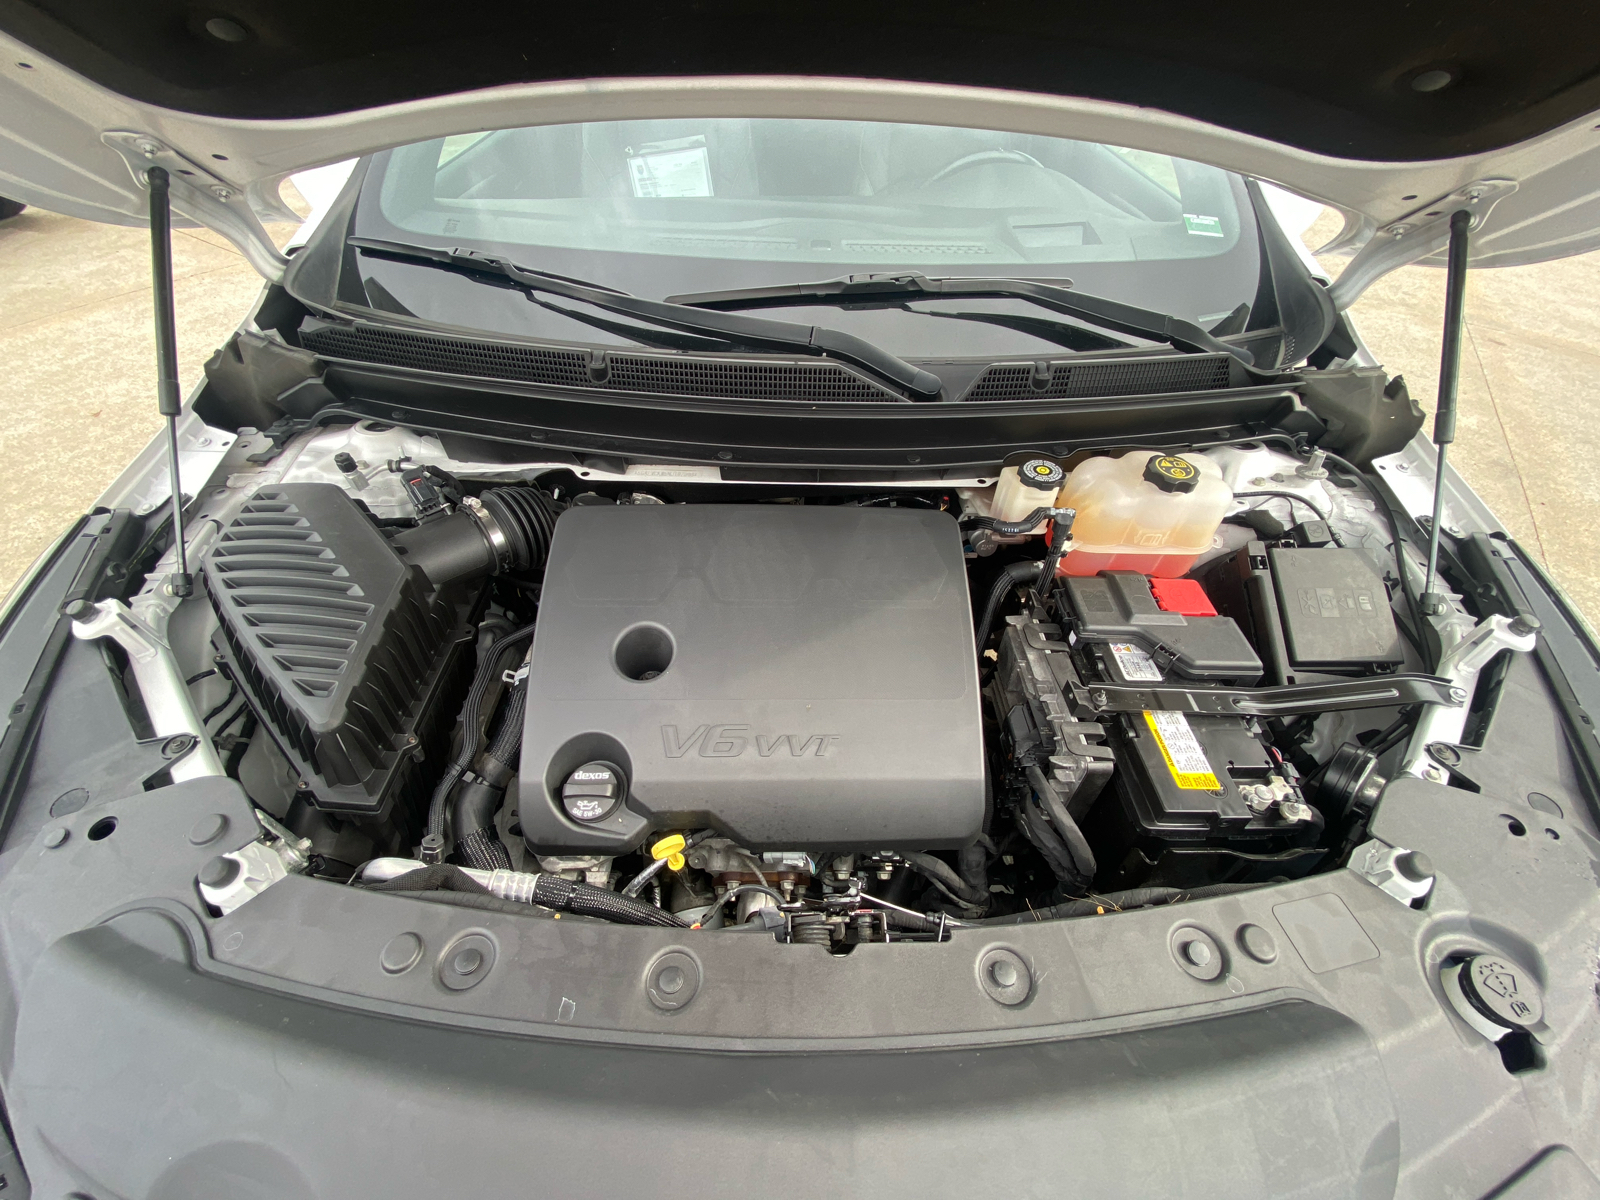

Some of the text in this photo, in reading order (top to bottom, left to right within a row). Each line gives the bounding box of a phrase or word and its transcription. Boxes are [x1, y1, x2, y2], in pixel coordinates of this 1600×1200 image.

[661, 724, 842, 758] V6 VVT
[574, 770, 611, 780] dexos
[572, 808, 602, 817] SAE 5W-30
